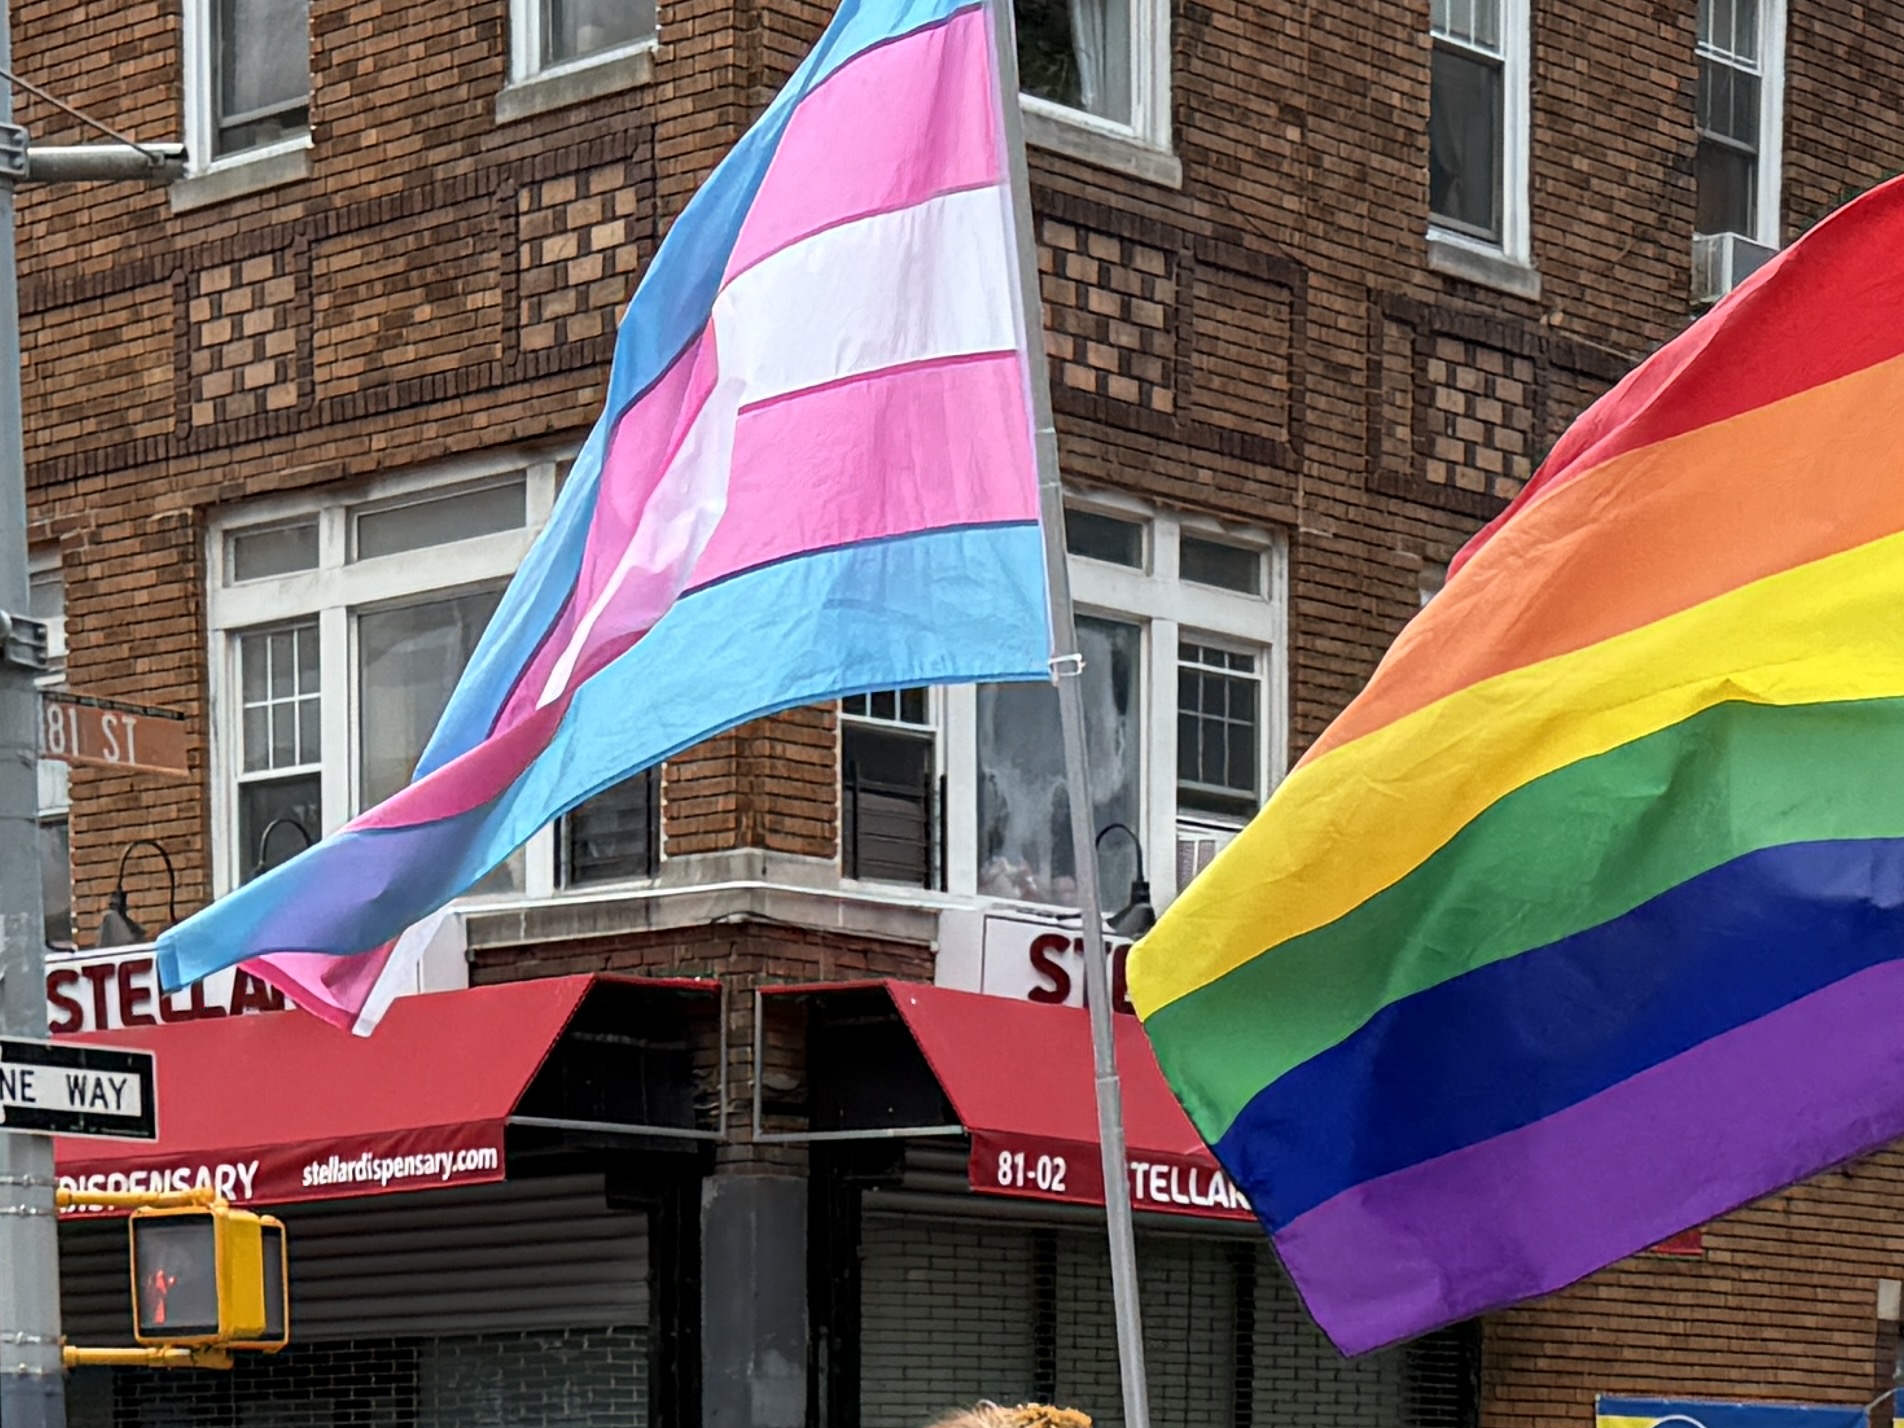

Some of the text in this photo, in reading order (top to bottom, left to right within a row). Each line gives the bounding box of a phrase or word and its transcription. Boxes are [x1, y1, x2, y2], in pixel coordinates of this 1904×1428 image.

[48, 704, 137, 764] 81 ST
[47, 958, 285, 1033] STELLA
[66, 1073, 128, 1111] WAY
[302, 1144, 498, 1187] stellardispensary.com
[997, 1151, 1067, 1193] 81-02
